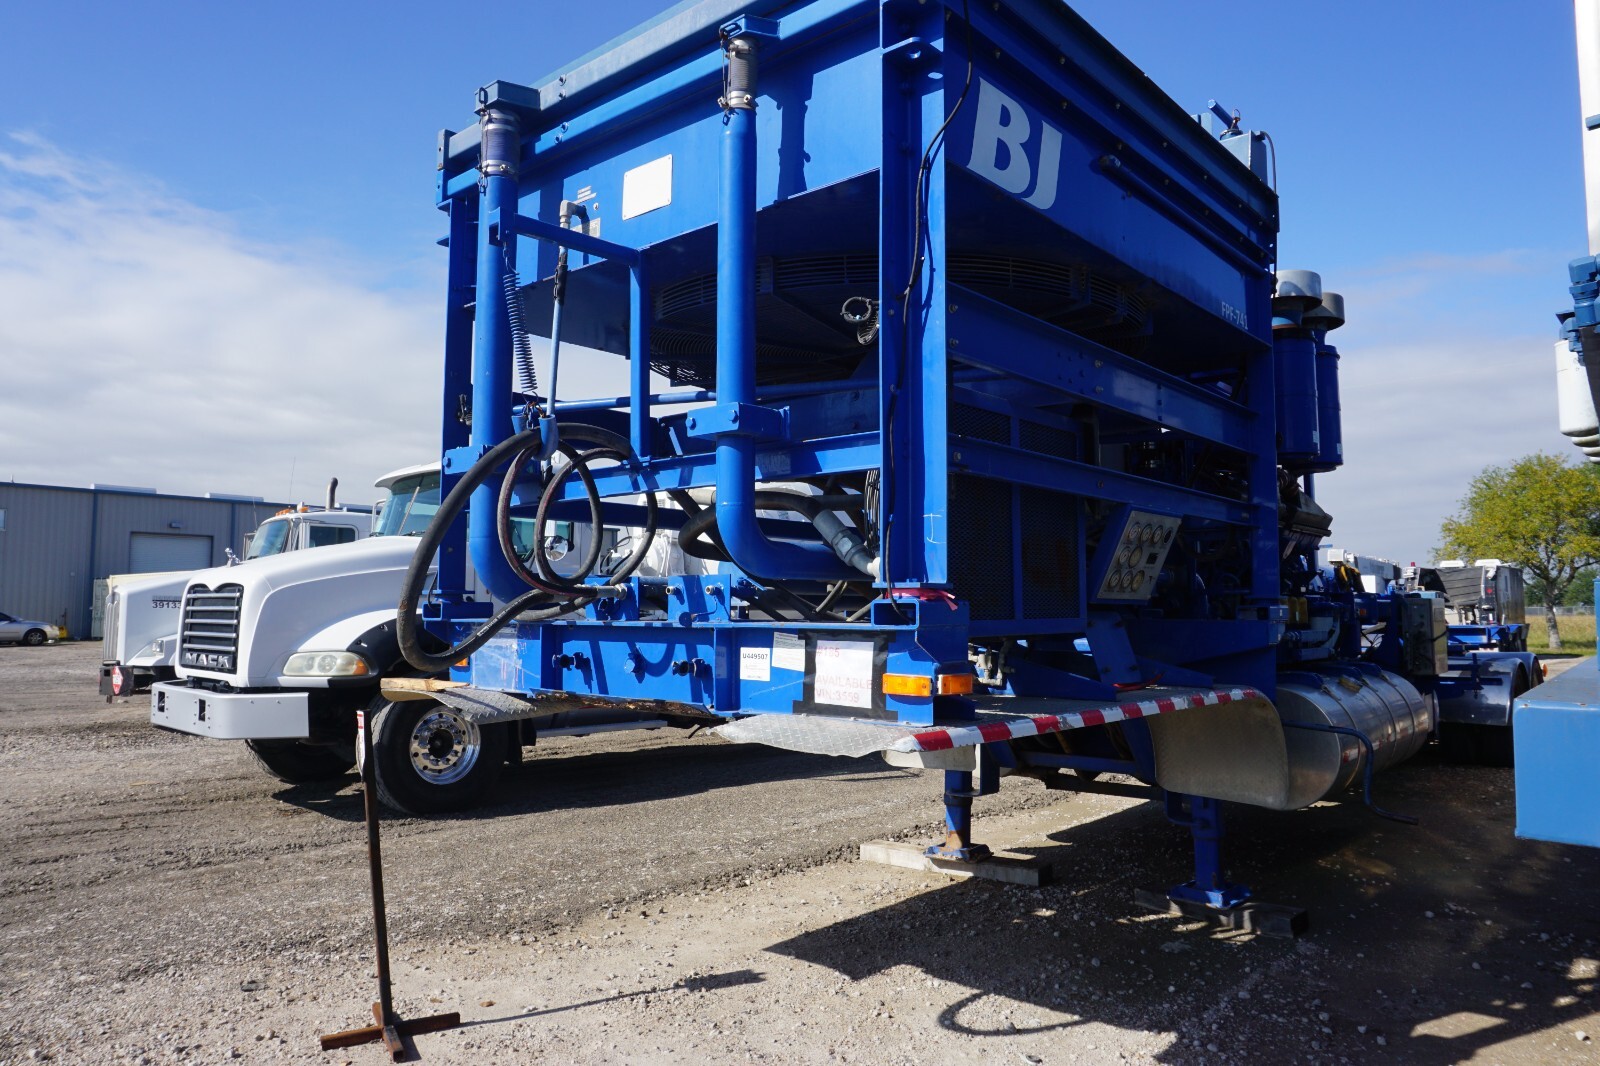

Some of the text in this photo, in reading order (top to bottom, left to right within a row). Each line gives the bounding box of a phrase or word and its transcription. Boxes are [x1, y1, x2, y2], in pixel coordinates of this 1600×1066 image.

[966, 75, 1063, 210] BJ
[1222, 302, 1248, 330] FPF-741
[185, 652, 229, 669] MACK
[815, 674, 873, 689] AVAILABLE
